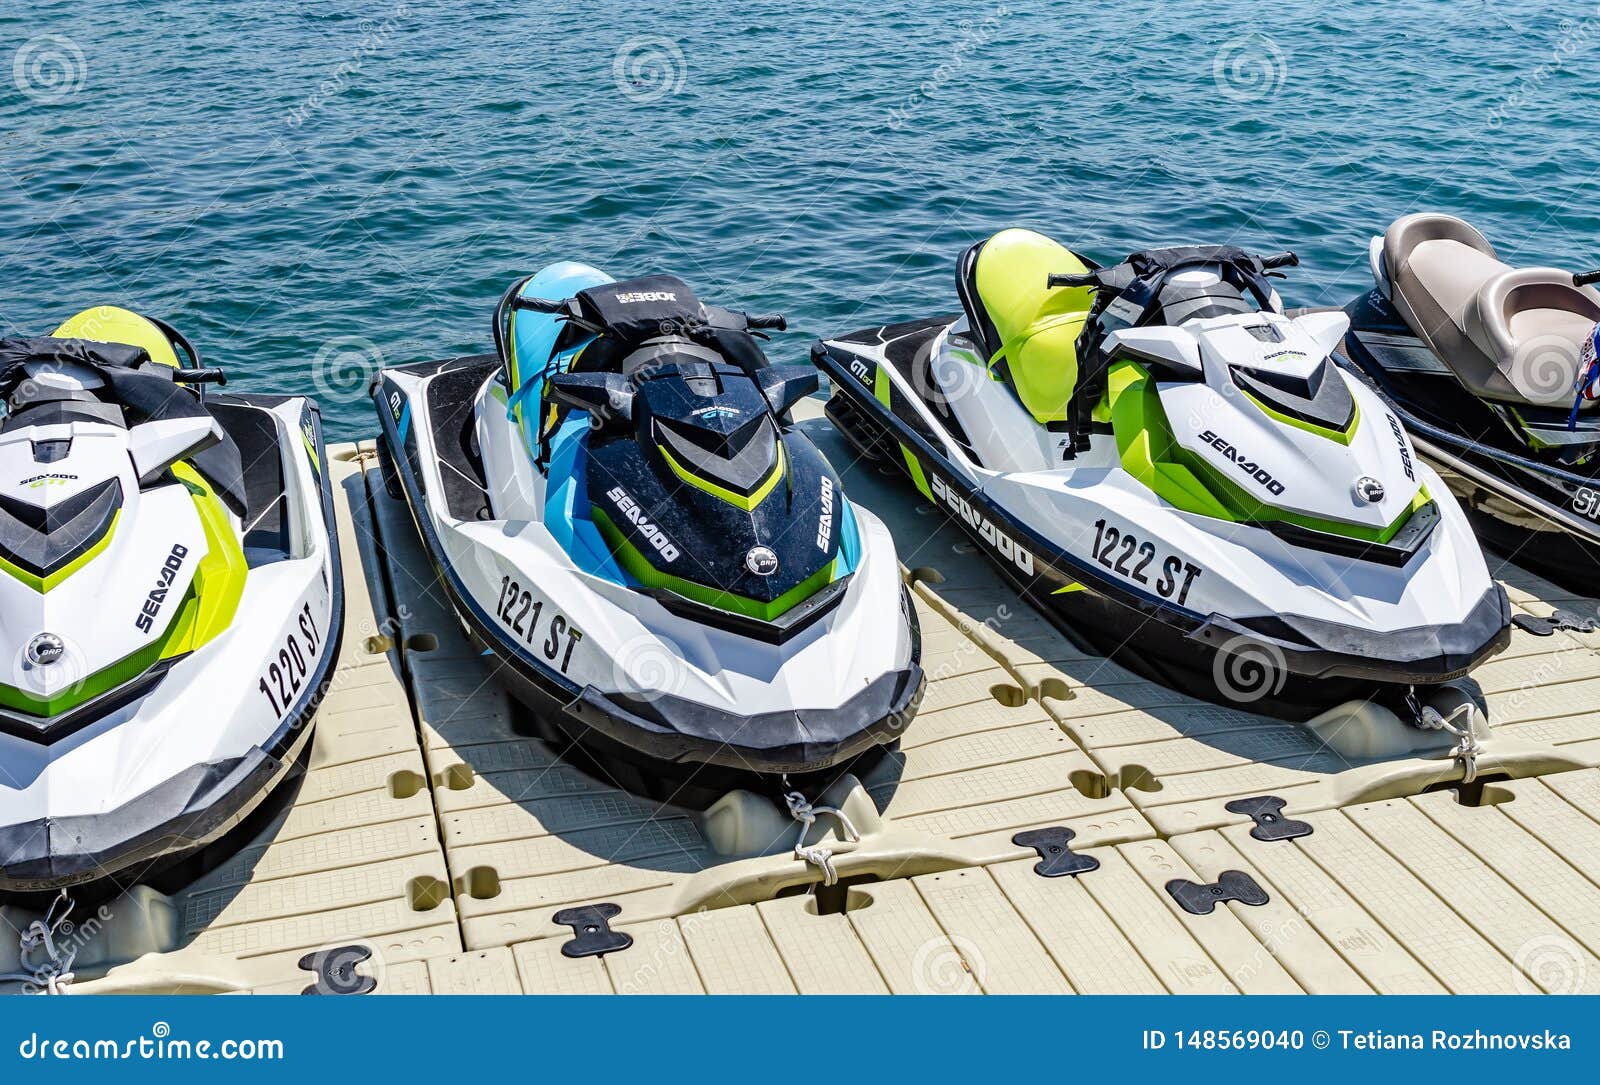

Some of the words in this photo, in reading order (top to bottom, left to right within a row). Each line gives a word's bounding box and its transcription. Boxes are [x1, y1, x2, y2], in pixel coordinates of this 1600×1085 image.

[1091, 518, 1156, 586] 1222
[1155, 555, 1203, 607] ST
[259, 633, 307, 720] 1220
[298, 601, 321, 657] ST
[496, 575, 543, 645] 1221
[543, 614, 584, 675] ST
